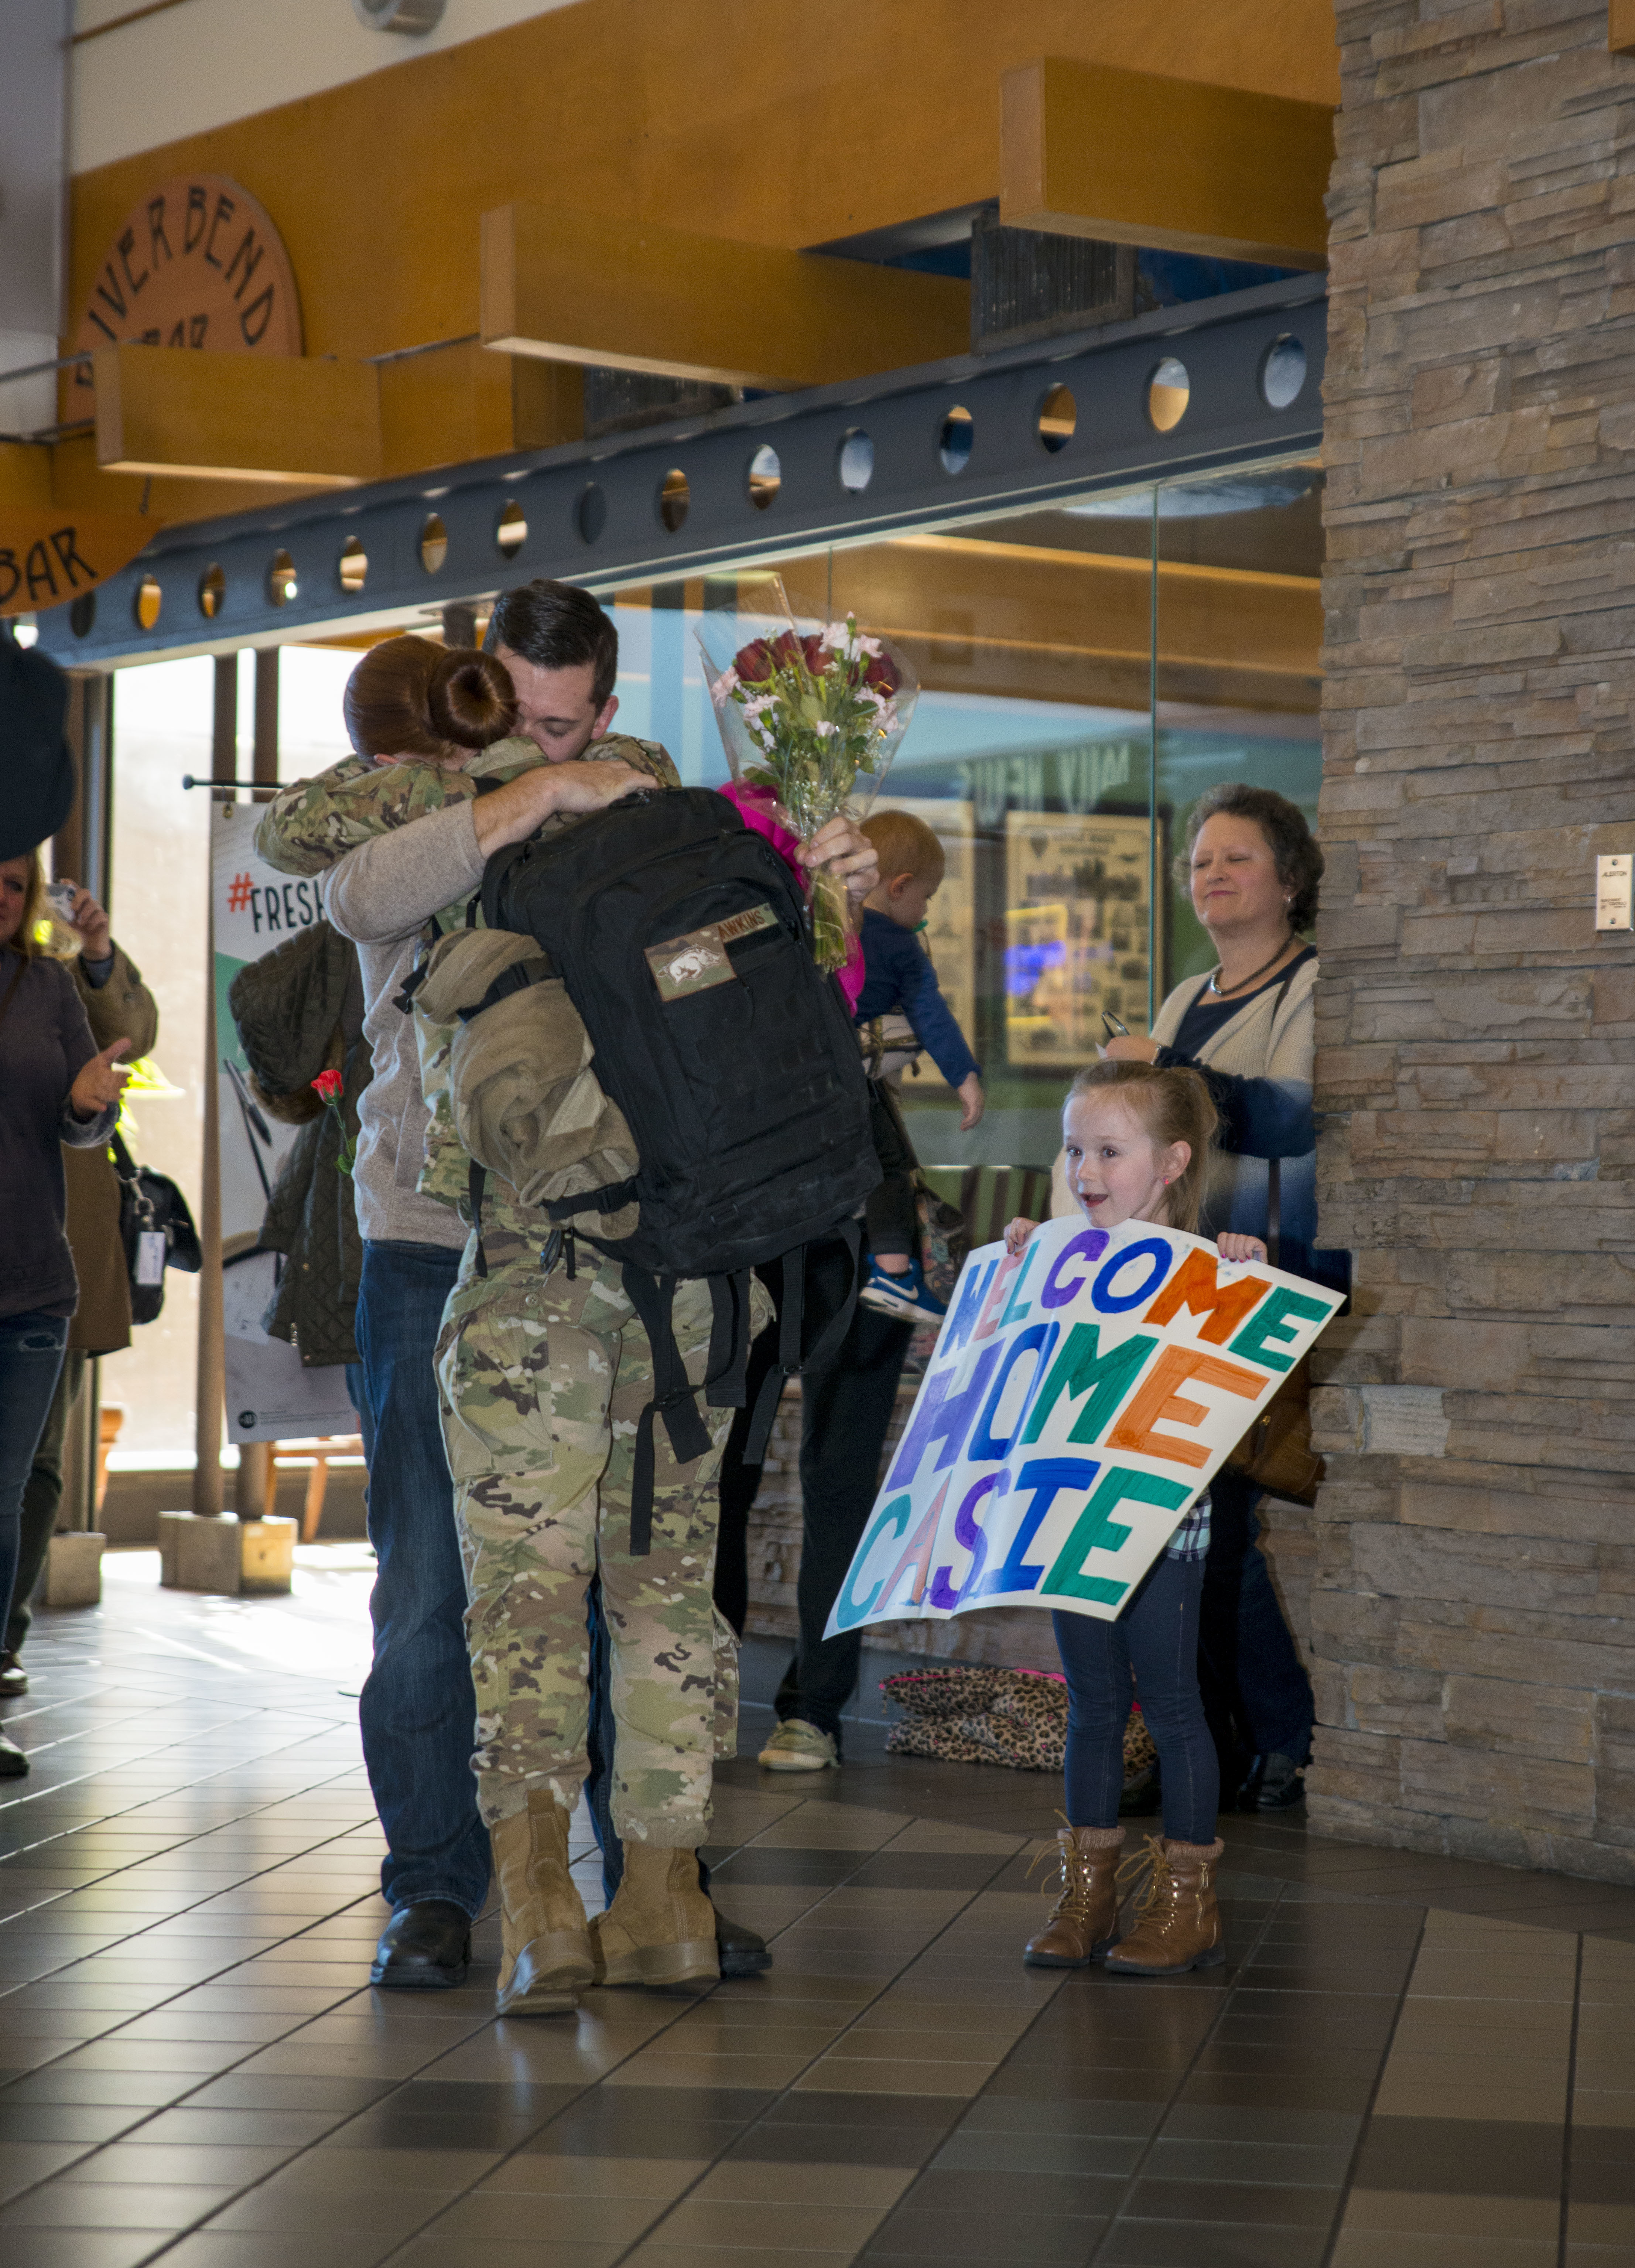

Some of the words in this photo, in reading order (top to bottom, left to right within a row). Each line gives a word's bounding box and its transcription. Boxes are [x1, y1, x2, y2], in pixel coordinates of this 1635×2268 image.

[718, 910, 765, 940] AWKINS
[941, 1230, 1333, 1372] WELCOME
[885, 1322, 1270, 1492] HOME
[837, 1457, 1193, 1628] CASIE
